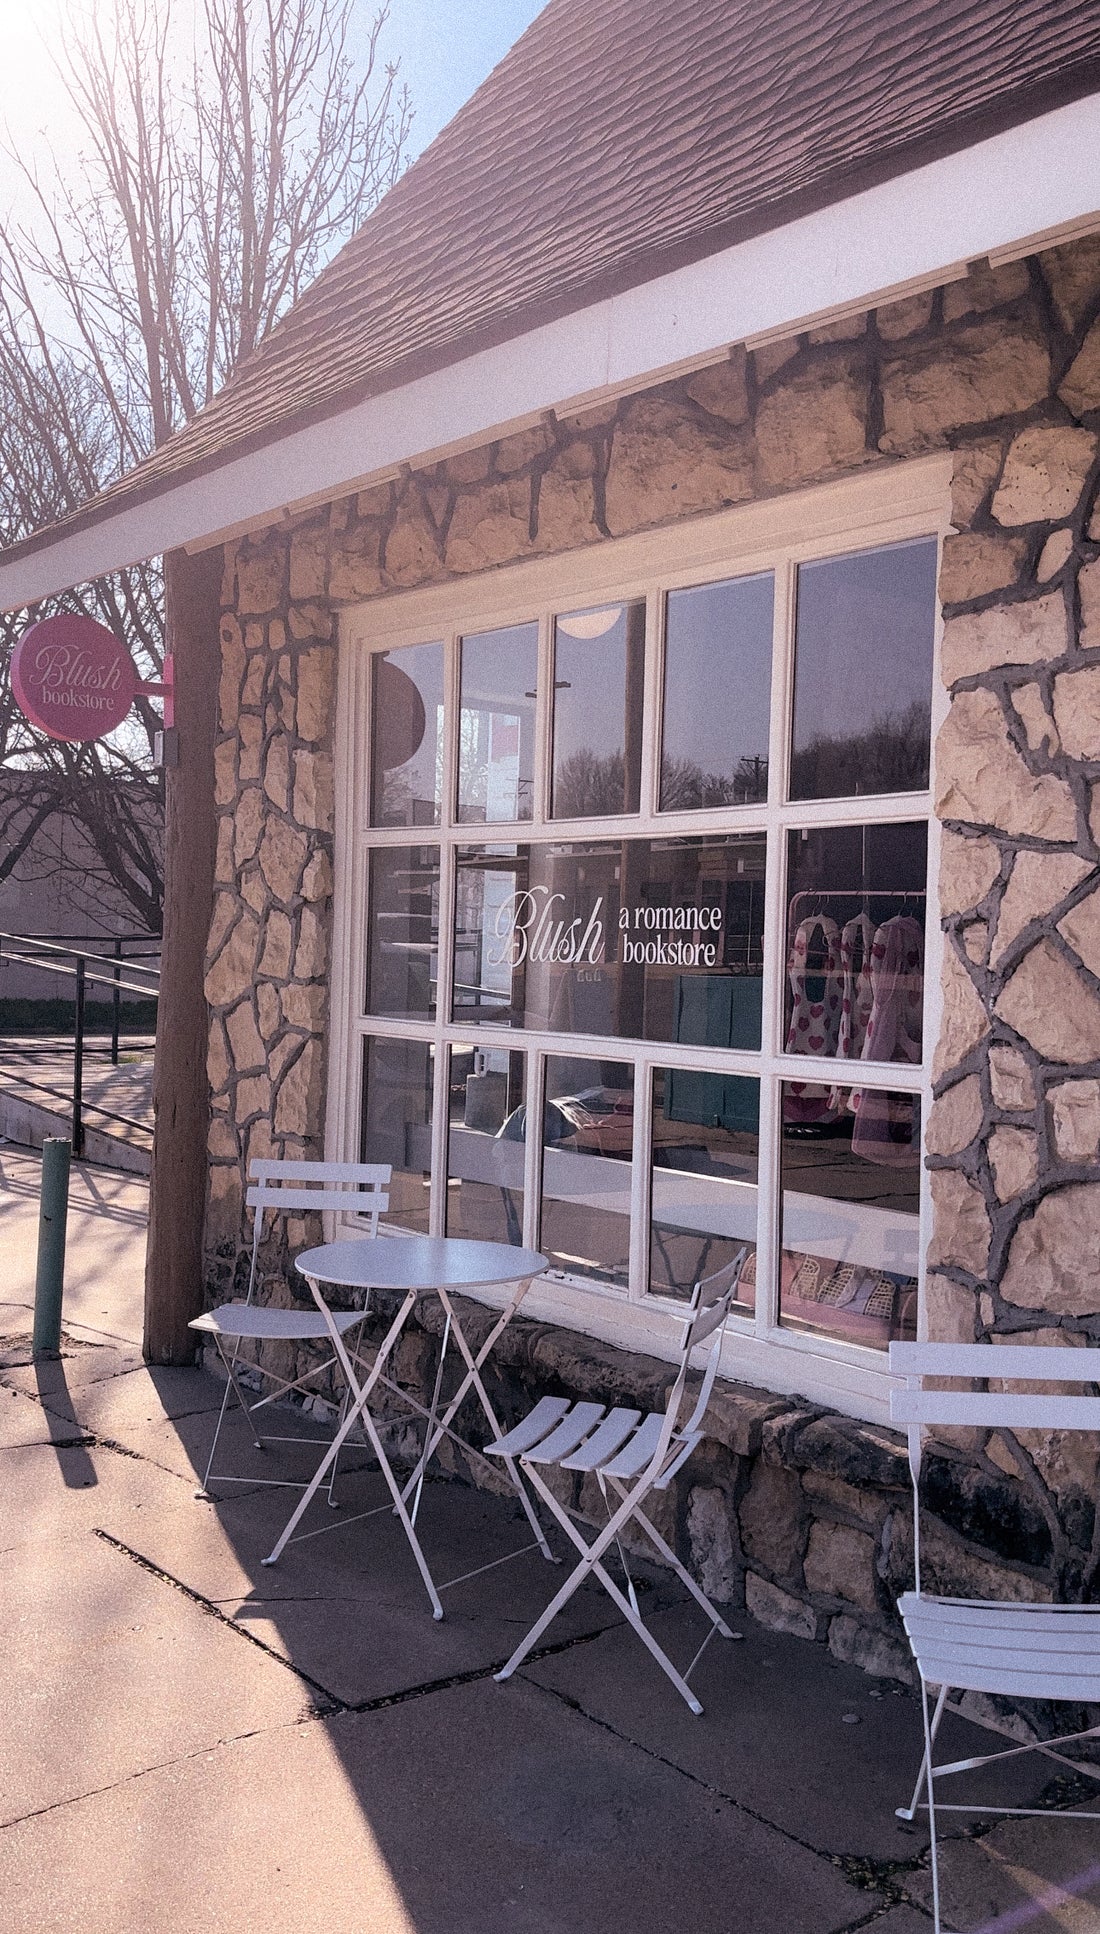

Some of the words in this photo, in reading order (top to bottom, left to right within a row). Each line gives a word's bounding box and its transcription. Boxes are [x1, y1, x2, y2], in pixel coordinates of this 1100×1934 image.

[29, 644, 121, 691] Blush
[42, 686, 114, 711] bookstore
[487, 885, 605, 968] Blush
[619, 907, 630, 930] a
[634, 907, 722, 931] romance
[622, 933, 716, 967] bookstore
